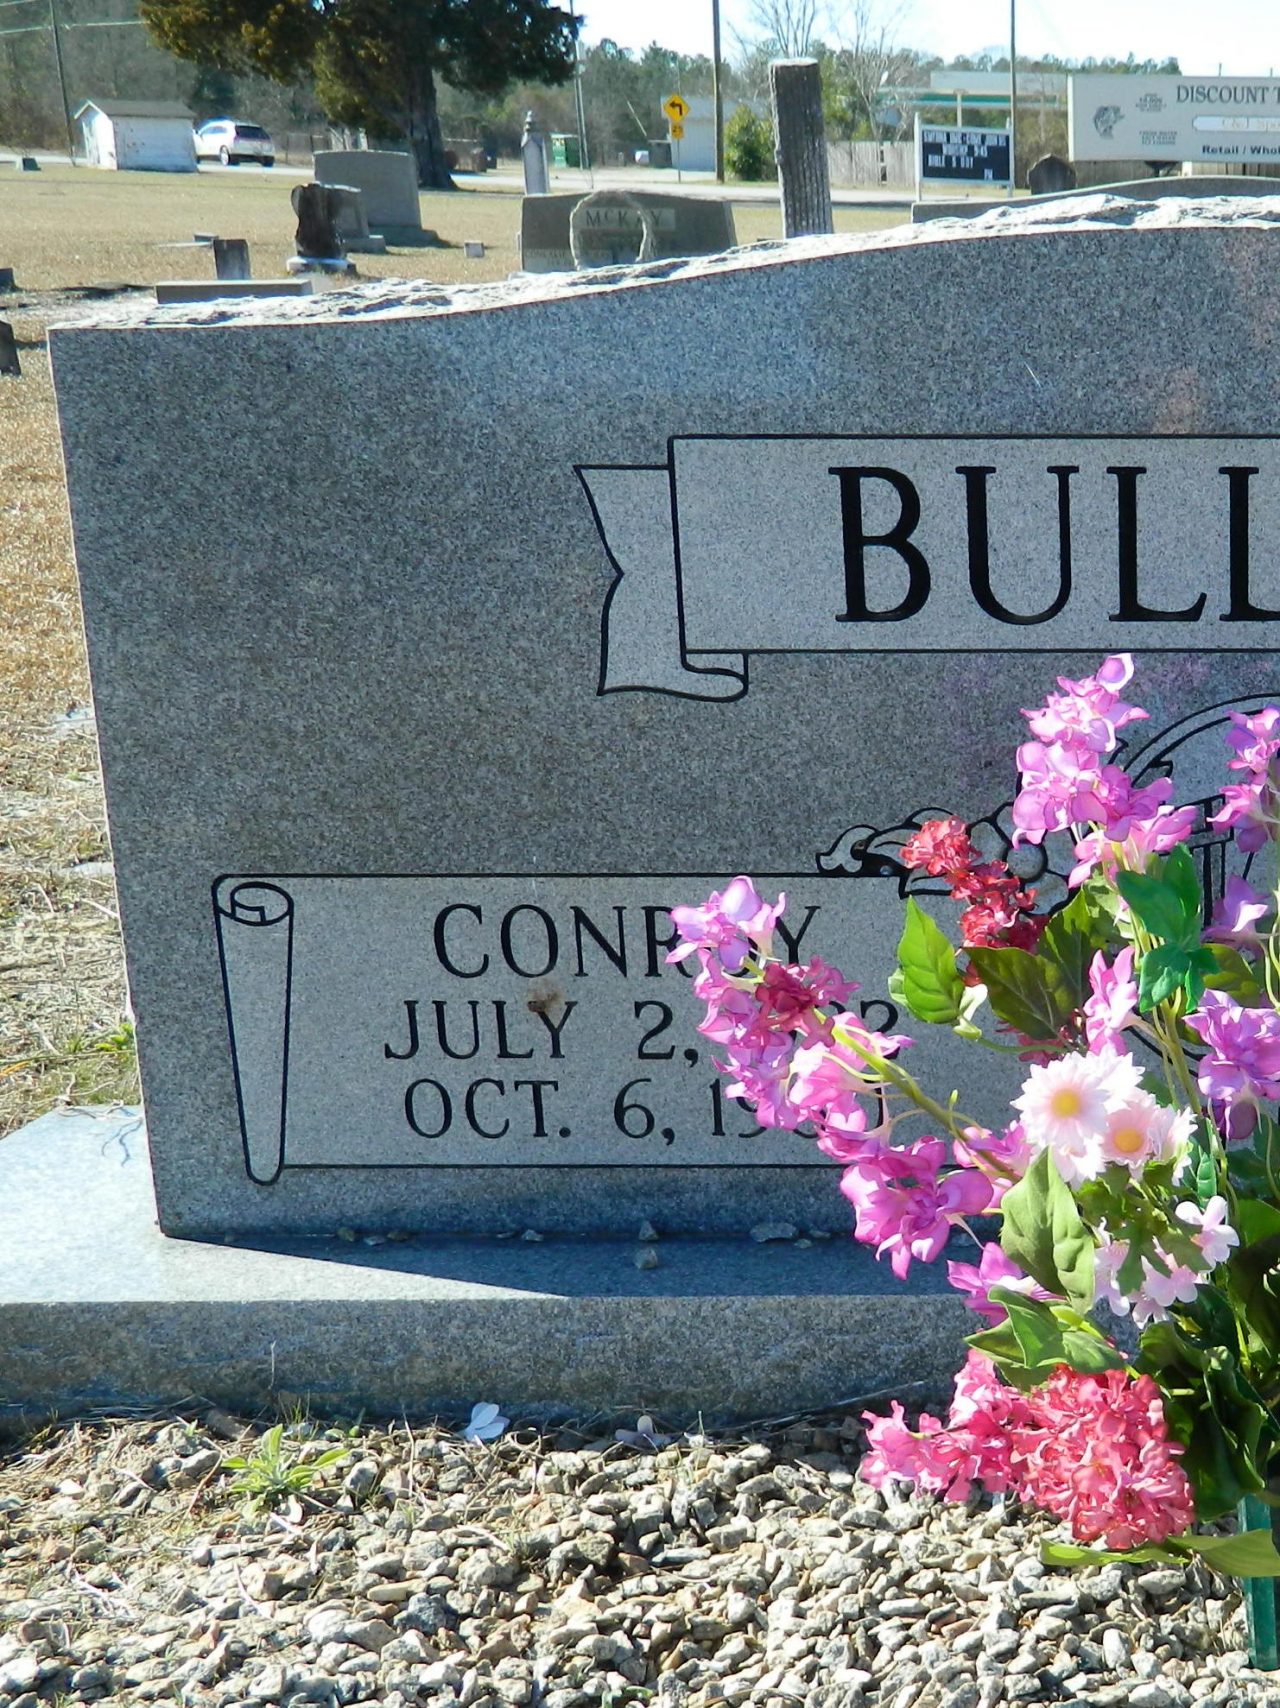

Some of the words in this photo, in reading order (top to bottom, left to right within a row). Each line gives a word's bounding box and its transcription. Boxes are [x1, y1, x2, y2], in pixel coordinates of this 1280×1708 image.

[1176, 85, 1269, 103] DISCOUNT
[1202, 144, 1239, 155] Retail
[385, 1000, 577, 1060] JULY
[634, 1000, 699, 1068] 2,
[404, 1078, 571, 1139] OCT.
[613, 1078, 675, 1146] 6,
